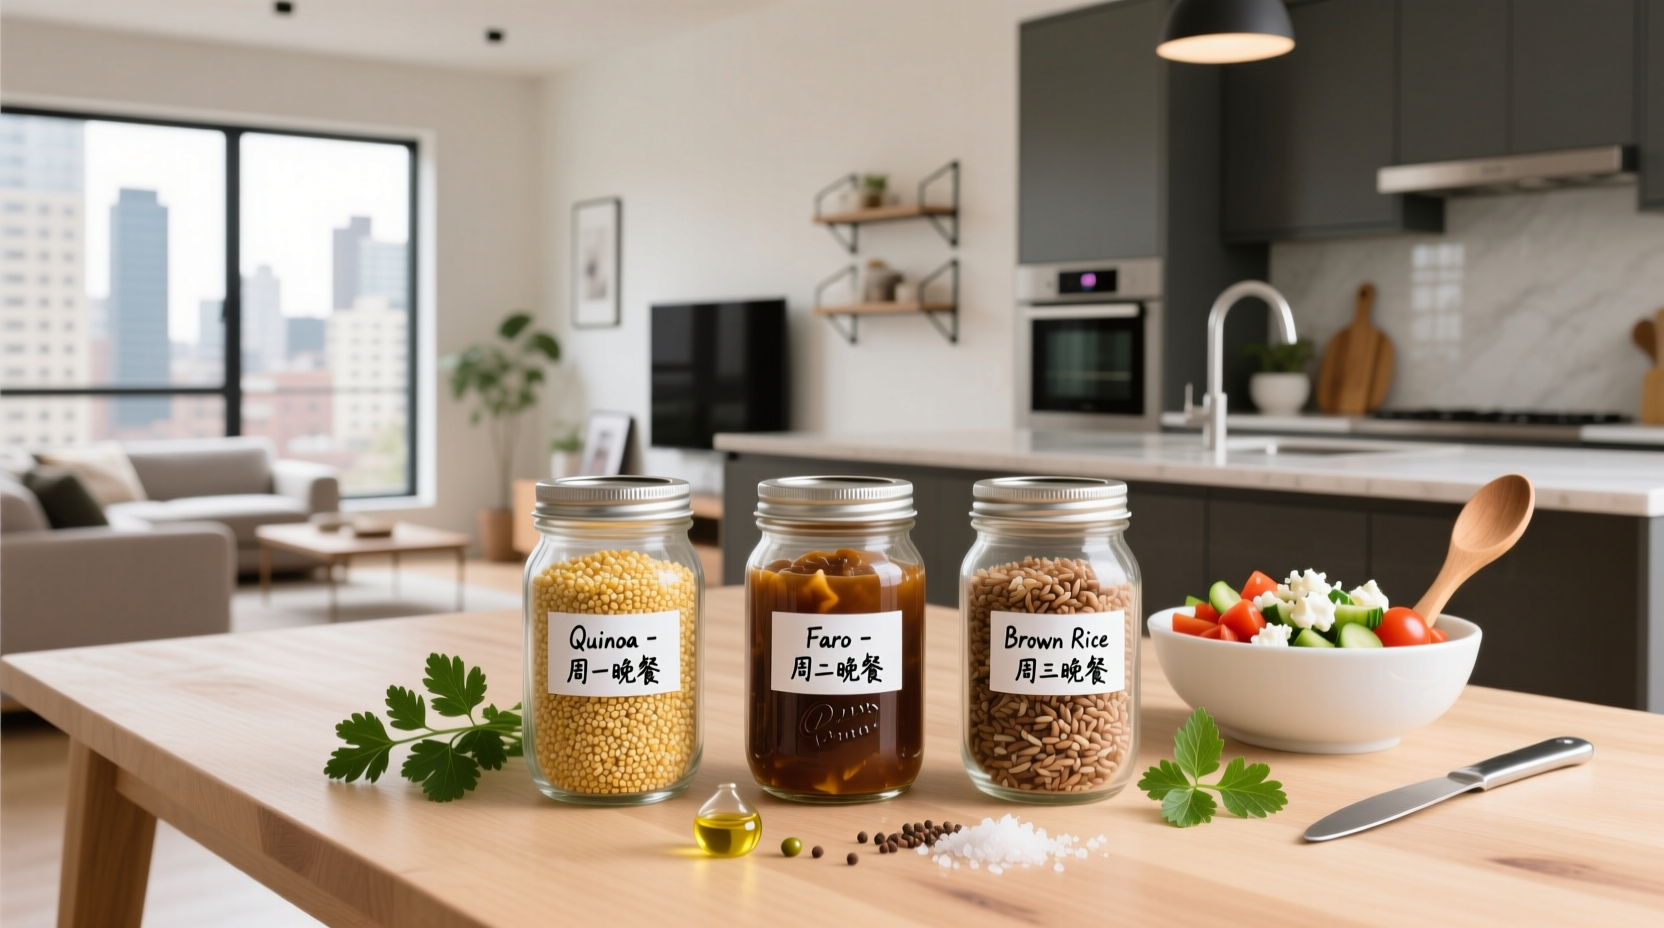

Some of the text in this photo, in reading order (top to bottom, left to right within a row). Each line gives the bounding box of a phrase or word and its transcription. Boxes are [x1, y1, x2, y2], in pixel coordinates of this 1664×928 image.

[569, 624, 639, 652] Quinoa
[806, 625, 852, 649] Faro
[1004, 625, 1109, 650] Brown Rice
[566, 654, 661, 686] 周一晚餐
[790, 652, 884, 684] 周二晚餐
[1014, 654, 1108, 686] 周三晚餐
